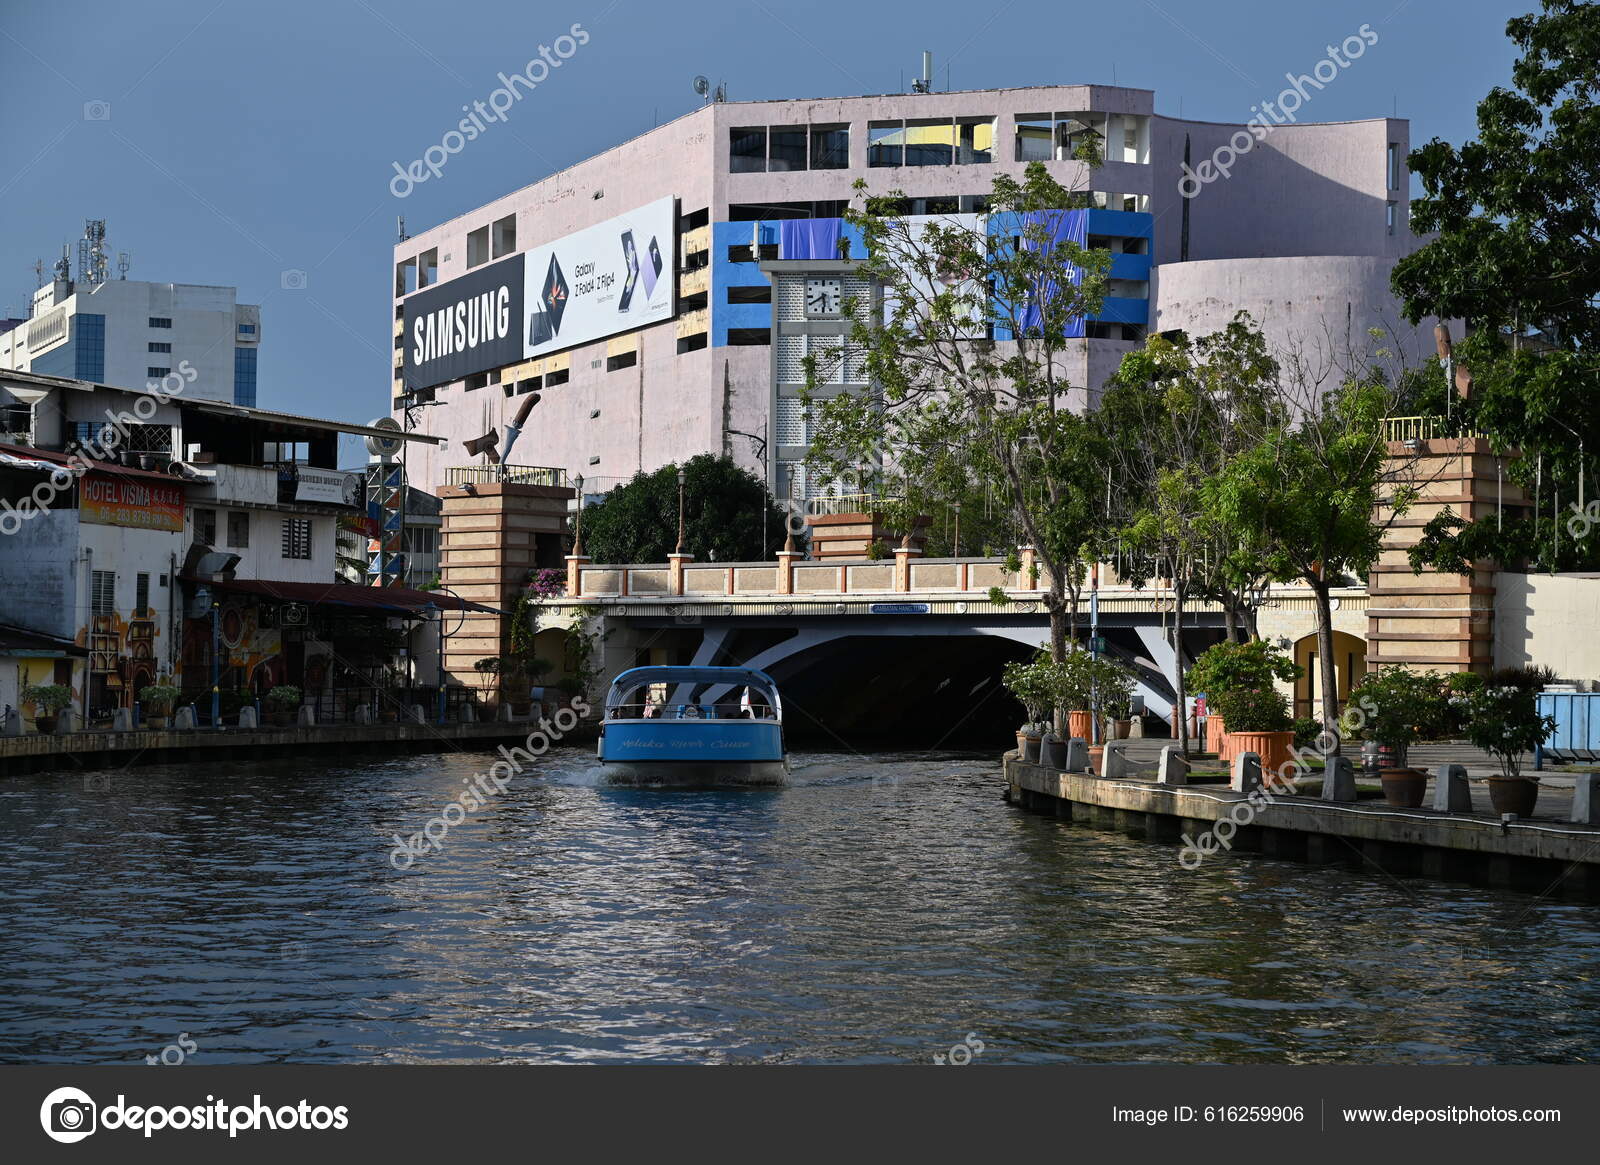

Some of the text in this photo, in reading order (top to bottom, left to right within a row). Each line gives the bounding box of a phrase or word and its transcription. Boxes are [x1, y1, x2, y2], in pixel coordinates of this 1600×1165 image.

[575, 261, 595, 278] Galaxy
[579, 279, 594, 296] Fold4
[596, 276, 601, 290] Z
[601, 272, 615, 292] Flip4
[413, 285, 510, 366] SAMSUNG
[84, 480, 151, 507] HOTEL VISMA
